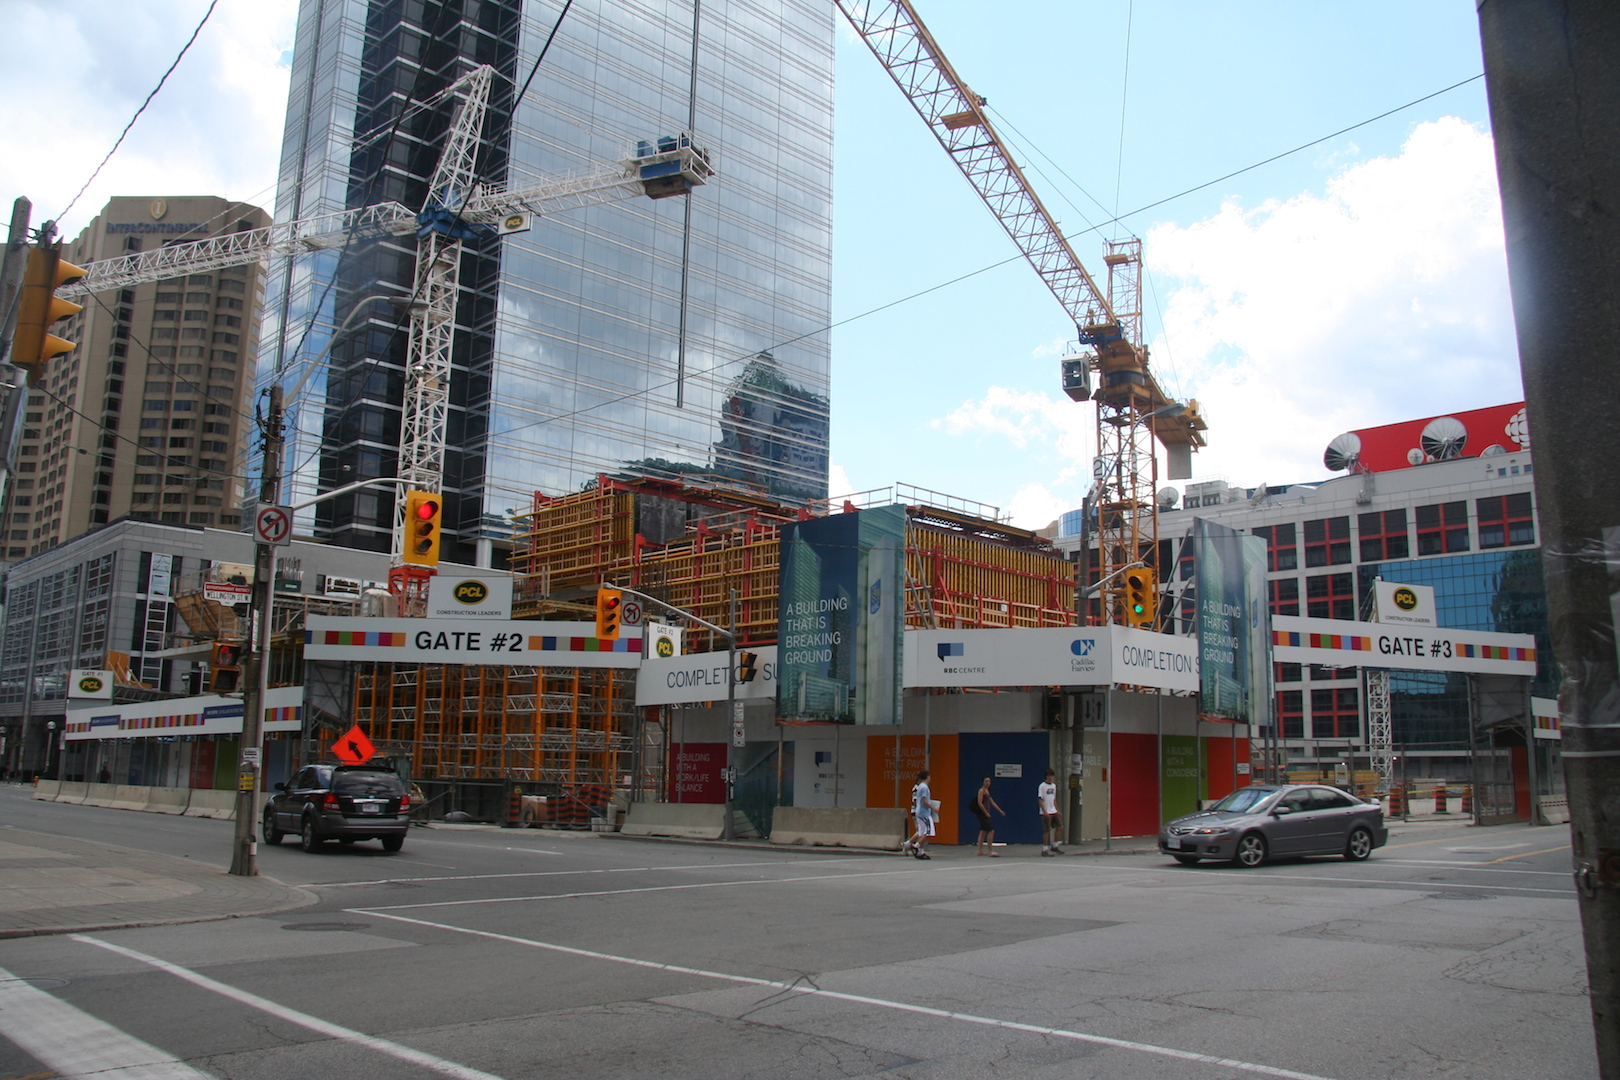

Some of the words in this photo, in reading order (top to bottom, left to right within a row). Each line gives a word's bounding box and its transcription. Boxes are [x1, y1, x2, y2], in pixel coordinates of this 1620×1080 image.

[1093, 459, 1103, 477] 2
[207, 592, 236, 600] WELLINGTON
[457, 586, 483, 597] PCL
[1396, 593, 1415, 604] PCL
[785, 603, 794, 616] A
[795, 597, 848, 615] BUILDING
[1202, 599, 1208, 612] A
[1208, 600, 1241, 619] BUILDING
[657, 625, 667, 634] GATE
[786, 617, 814, 632] THAT
[816, 616, 827, 629] IS
[1203, 615, 1221, 630] THAT
[1221, 618, 1229, 632] IS
[414, 630, 481, 651] GATE
[489, 632, 523, 652] #2
[785, 631, 841, 648] BREAKING
[1203, 632, 1239, 649] BREAKING
[658, 641, 672, 655] PCL
[1378, 635, 1425, 656] GATE
[1430, 639, 1452, 659] #3
[784, 649, 833, 665] GROUND
[1070, 658, 1095, 666] Cadillac
[1122, 645, 1192, 673] COMPLETION
[1203, 647, 1234, 664] GROUND
[81, 680, 100, 690] PCL
[682, 753, 710, 762] BUILDING
[884, 748, 890, 756] A
[892, 747, 925, 757] BUILDIN
[676, 763, 691, 771] WTH
[884, 759, 905, 768] THT
[907, 759, 926, 768] PAYS
[1166, 768, 1198, 777] CONSCIENCE
[675, 783, 703, 792] BLANCE
